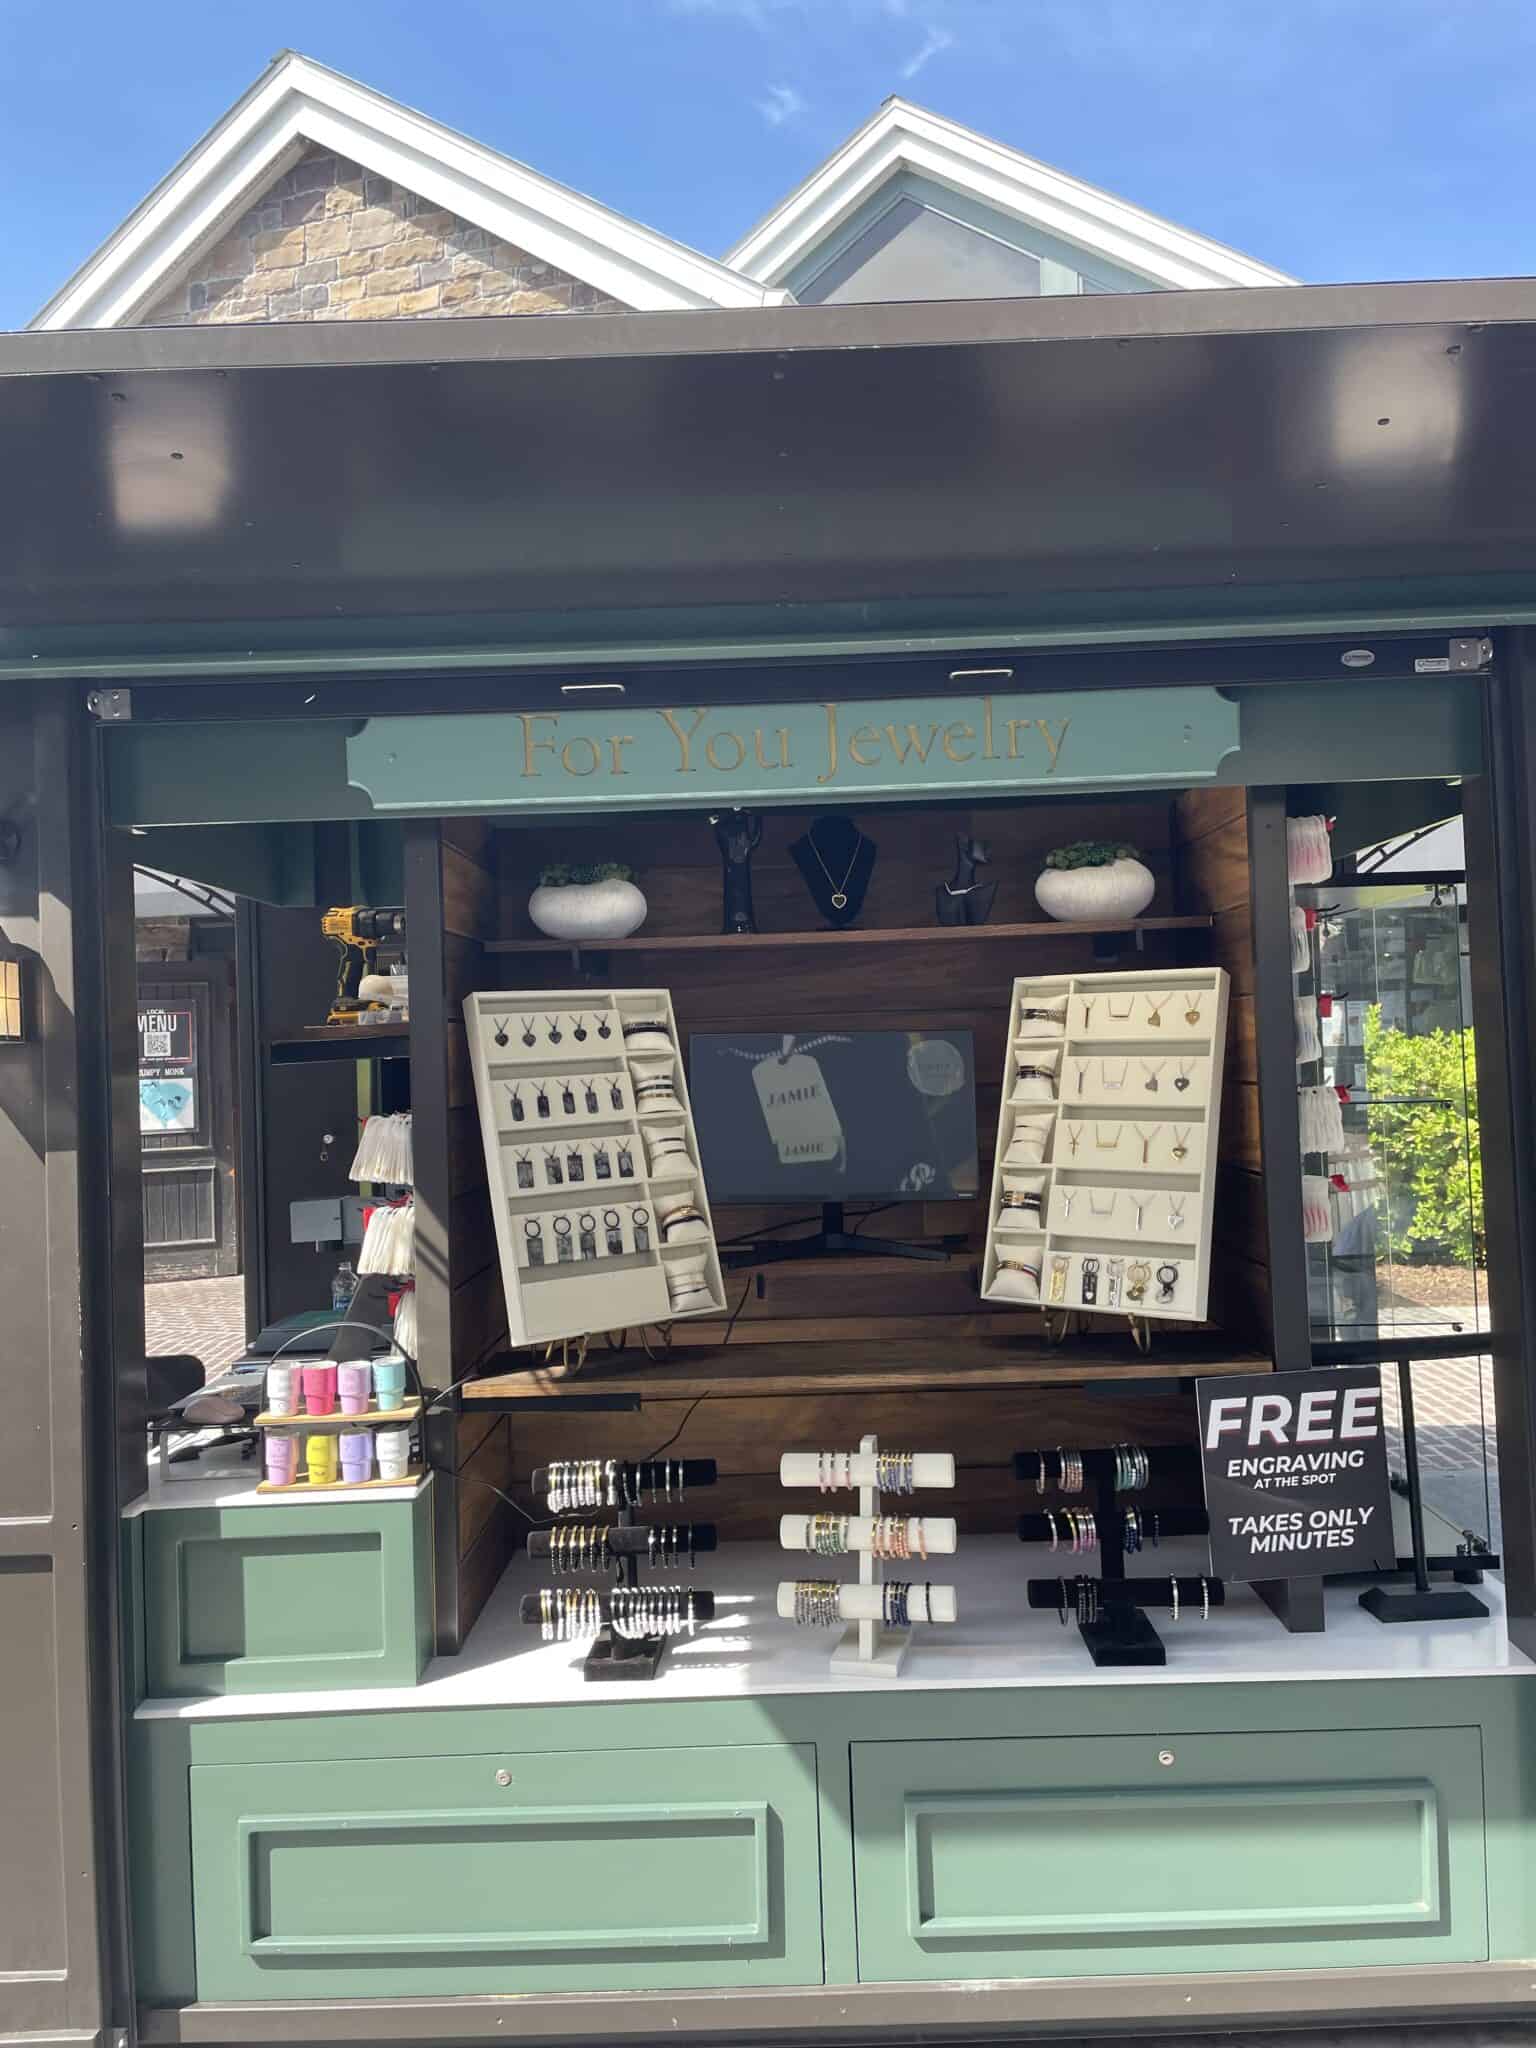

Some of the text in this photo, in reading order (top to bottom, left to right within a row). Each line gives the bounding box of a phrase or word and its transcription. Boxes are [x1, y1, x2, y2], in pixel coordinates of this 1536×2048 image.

[516, 694, 1072, 784] For You Jewelry
[1206, 1387, 1381, 1449] FREE
[1227, 1450, 1365, 1478] ENGRAVING
[1254, 1473, 1337, 1490] AT THE SPOT
[1228, 1506, 1375, 1535] TAKES ONLY
[1250, 1528, 1355, 1554] MINUTES
